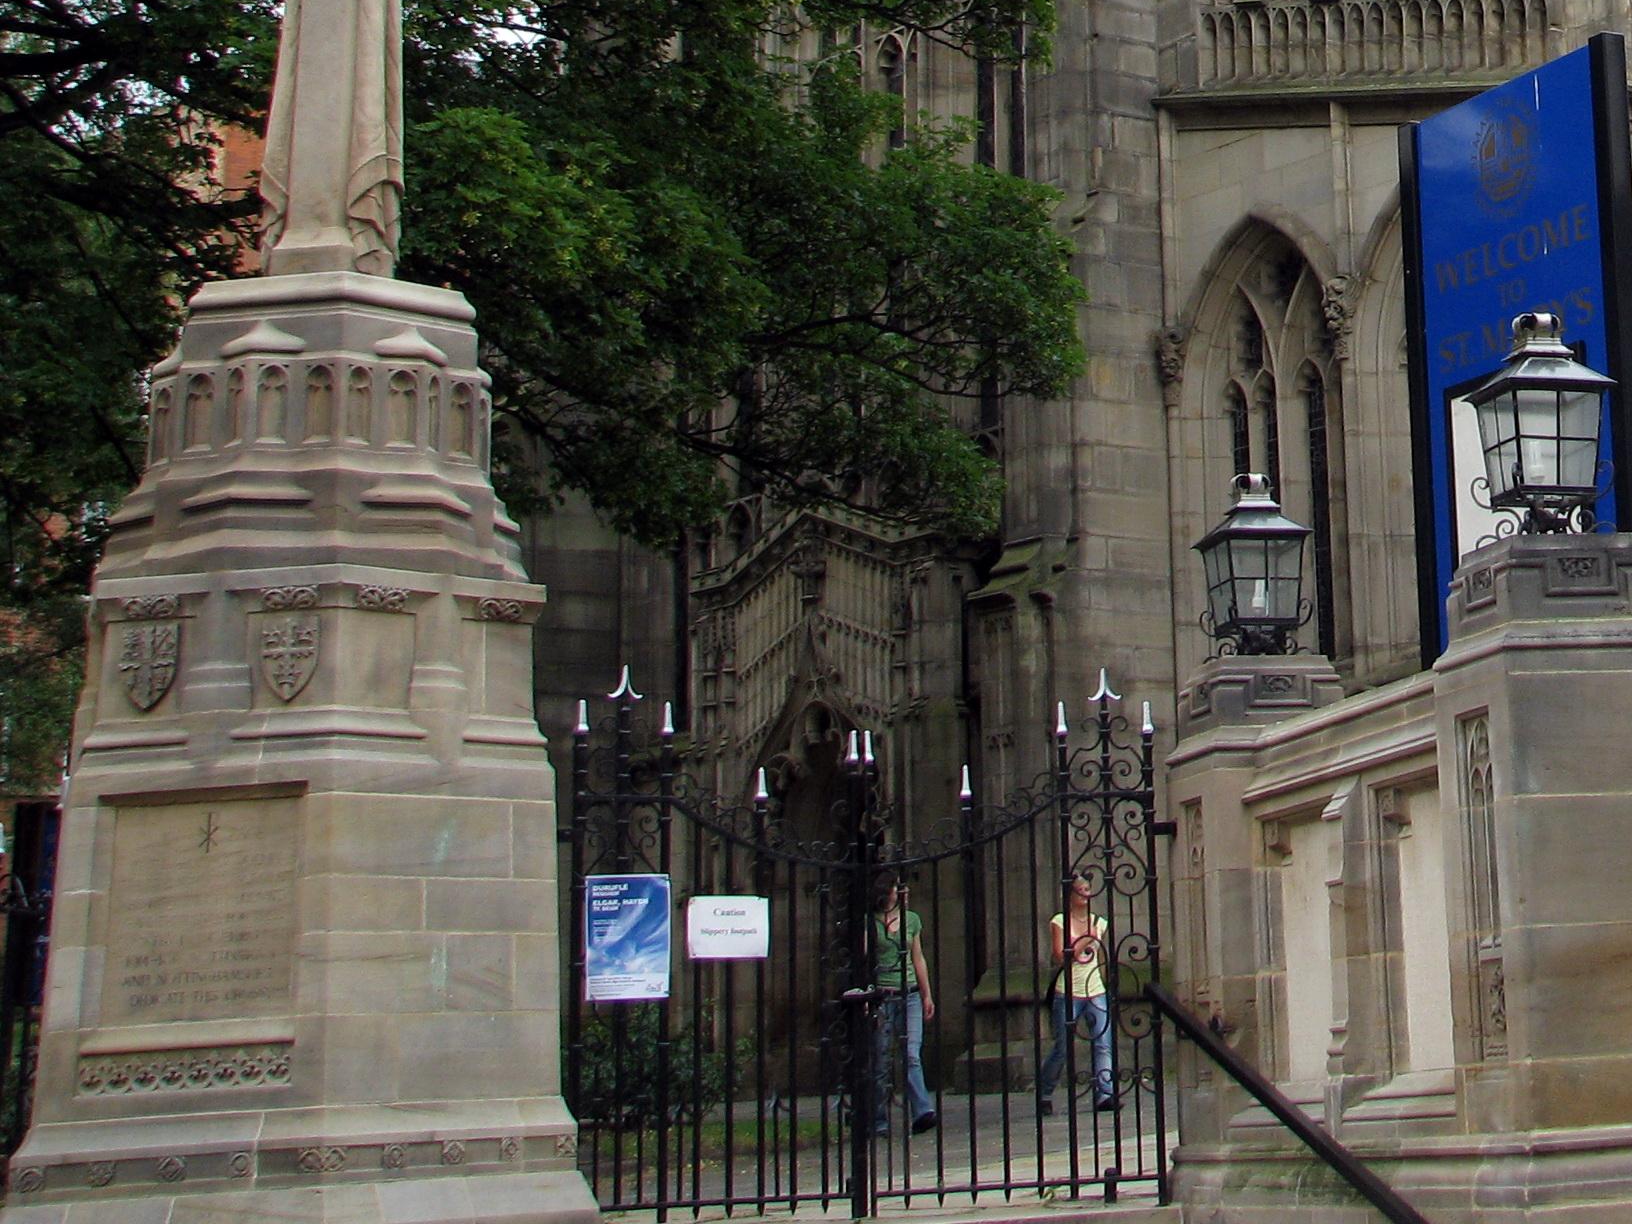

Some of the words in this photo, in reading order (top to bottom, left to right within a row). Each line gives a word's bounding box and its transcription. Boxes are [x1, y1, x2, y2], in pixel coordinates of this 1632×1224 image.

[1436, 204, 1592, 294] WELCOME
[1497, 279, 1528, 308] TO
[1480, 286, 1595, 359] MY'S
[713, 907, 746, 917] Caution
